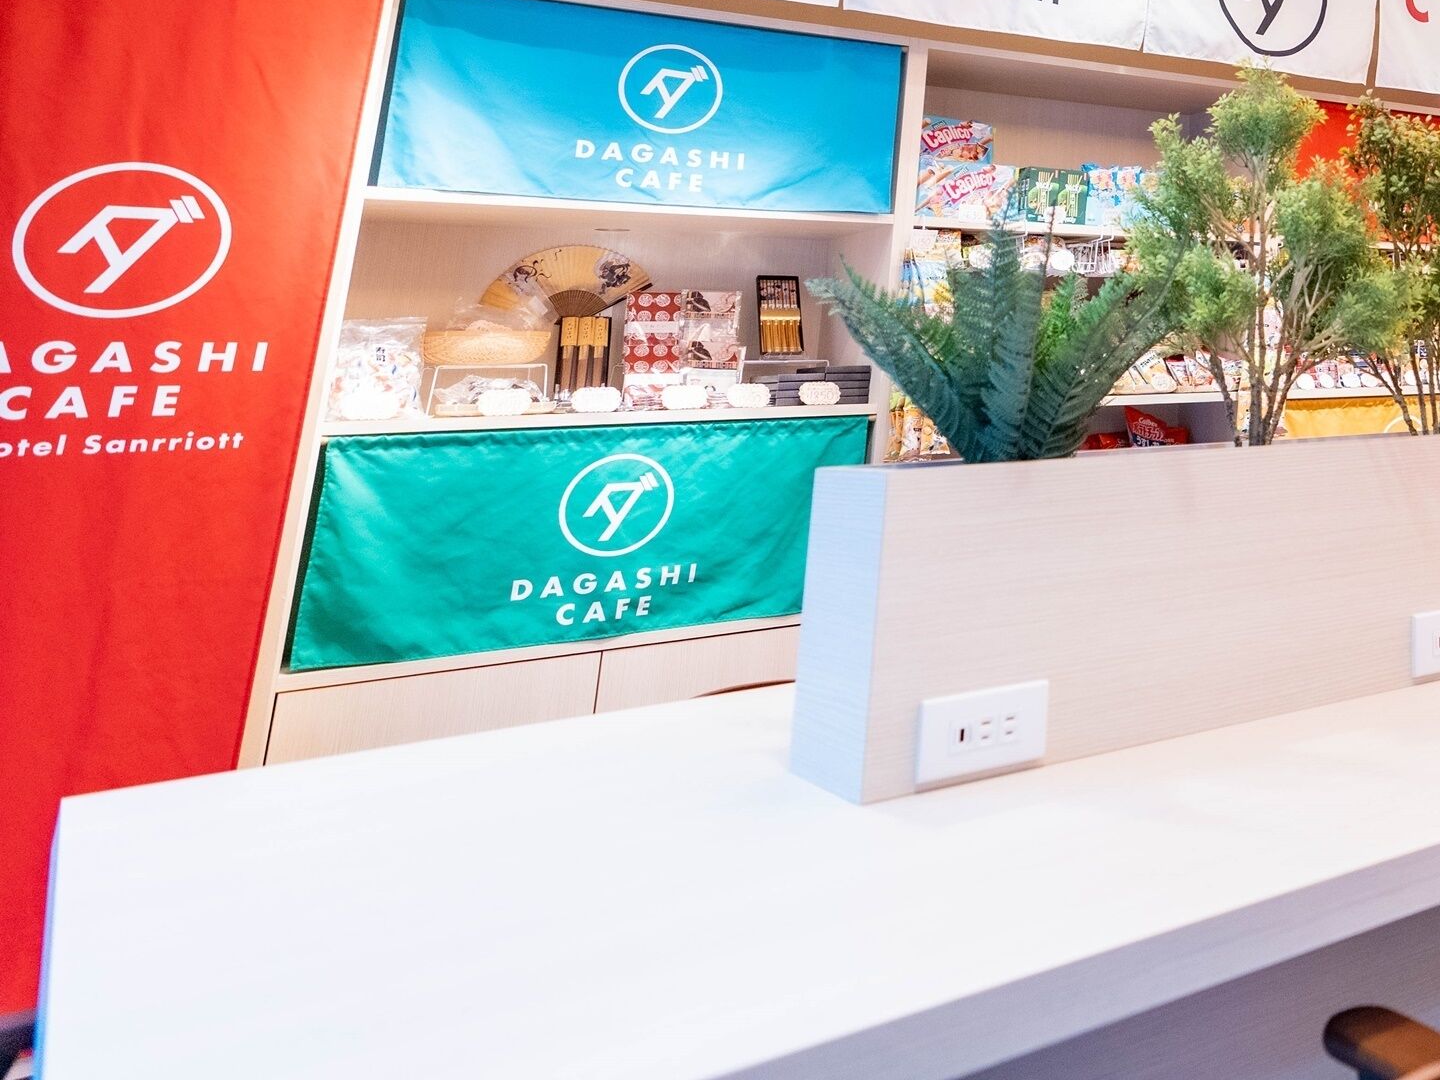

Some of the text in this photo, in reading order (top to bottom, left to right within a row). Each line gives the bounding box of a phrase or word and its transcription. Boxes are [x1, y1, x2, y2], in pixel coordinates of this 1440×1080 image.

[575, 139, 745, 170] DAGASHI
[615, 168, 703, 192] CAFE
[0, 385, 181, 420] CAFE
[82, 431, 244, 455] Sanrriott
[510, 563, 697, 601] DAGASHI
[555, 595, 652, 625] CAFE
